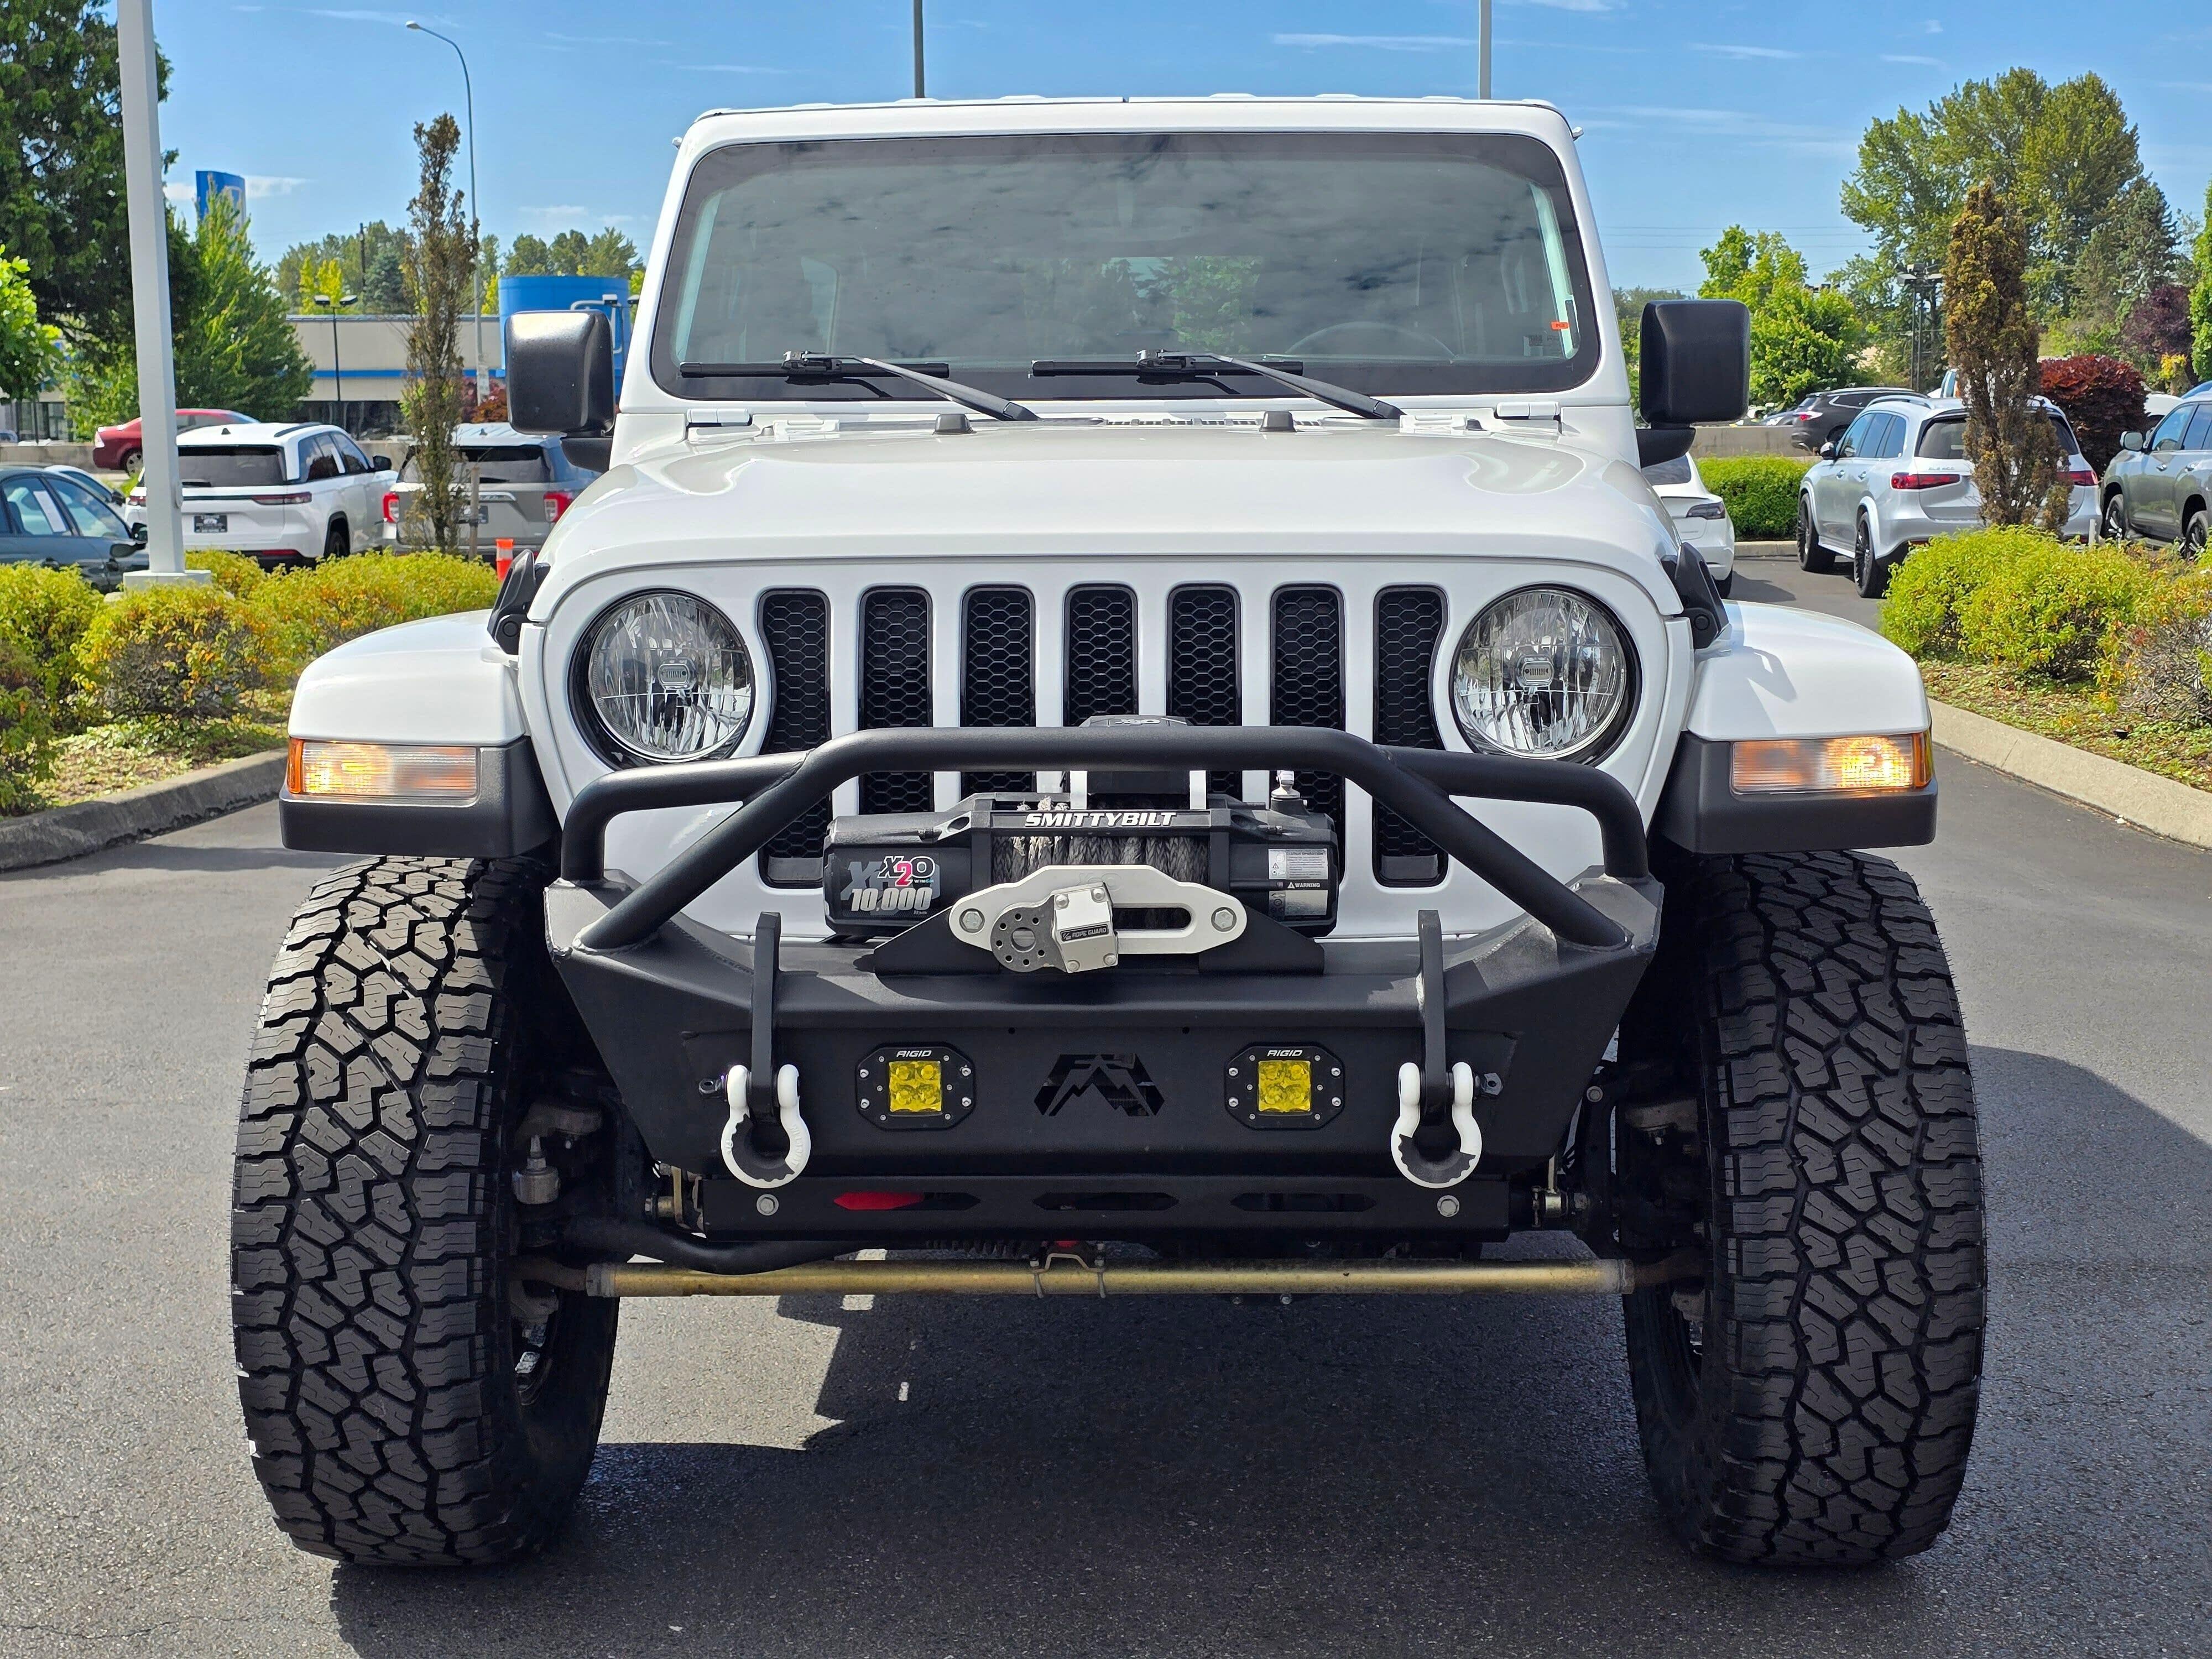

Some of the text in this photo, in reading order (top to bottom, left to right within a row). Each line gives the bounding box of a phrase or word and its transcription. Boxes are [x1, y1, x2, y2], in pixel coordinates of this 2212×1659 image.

[1024, 812, 1176, 827] SMITTYBILT
[877, 856, 936, 887] X2O
[851, 887, 933, 911] 10,000
